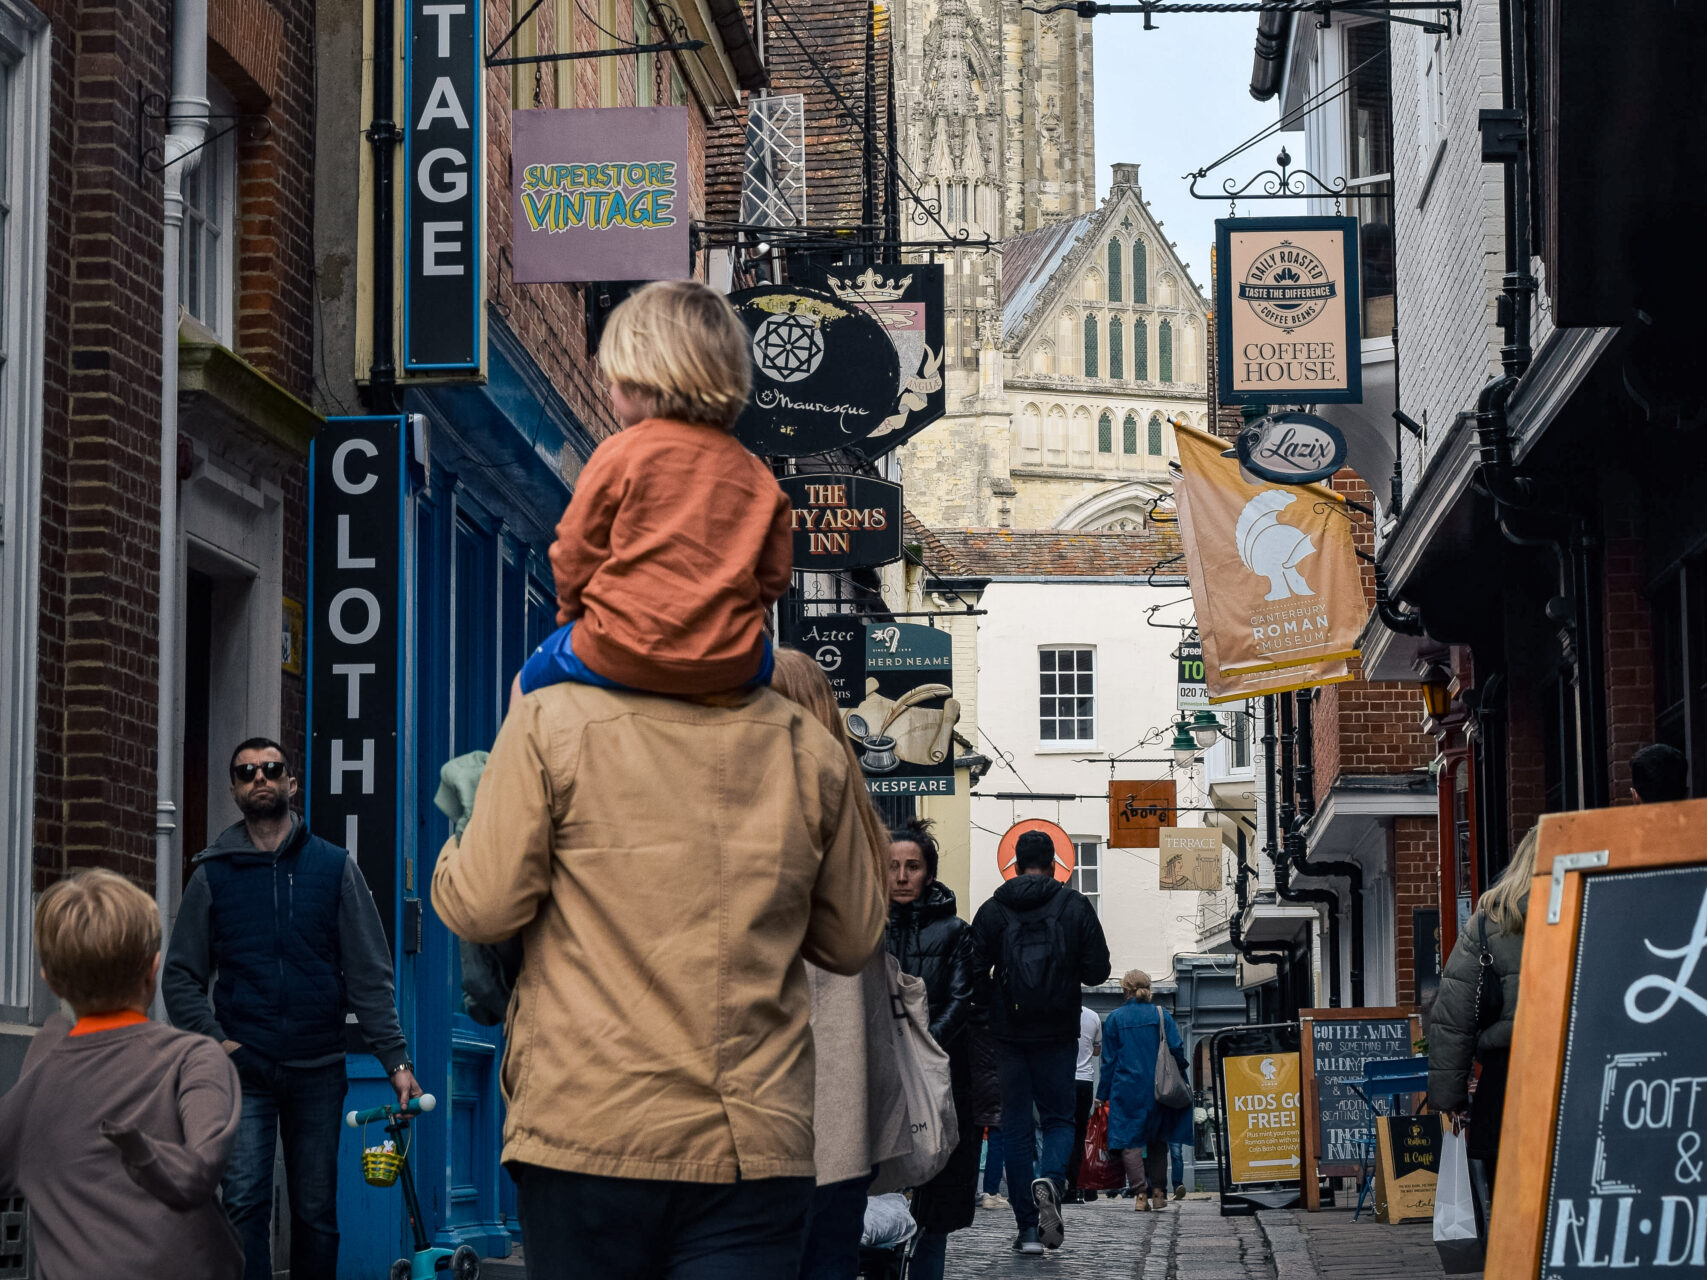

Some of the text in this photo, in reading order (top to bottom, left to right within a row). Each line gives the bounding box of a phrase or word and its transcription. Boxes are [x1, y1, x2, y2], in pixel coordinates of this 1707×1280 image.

[522, 161, 677, 190] SUPERSTORE
[521, 189, 677, 233] VINTAGE
[1251, 251, 1323, 281] DAILY ROASTED
[1245, 286, 1331, 298] TASTE THE DIFFERENCE
[1260, 306, 1316, 325] COFFEE BEANS
[1244, 342, 1336, 361] COFFEE
[1244, 362, 1336, 382] HOUSE
[804, 484, 846, 506] THE
[790, 508, 887, 530] TY ARMS
[808, 533, 849, 554] INN
[1250, 604, 1327, 625] CANTERBURY
[802, 626, 855, 641] Aztec
[1253, 614, 1330, 640] ROMAN
[1261, 631, 1325, 651] MUSEUM
[868, 657, 950, 667] HERD NEAME
[1181, 661, 1205, 680] TO
[828, 678, 846, 687] ver
[1180, 687, 1197, 698] 020
[1166, 838, 1216, 851] TERRACE
[1366, 1024, 1407, 1039] WINE
[1317, 1041, 1333, 1051] AND
[1339, 1041, 1382, 1051] SOMETHING
[1234, 1093, 1277, 1111] KIDS
[1338, 1099, 1389, 1111] ADDITINAL
[1623, 1077, 1707, 1130] COFF
[1247, 1111, 1297, 1129] FREE!
[1322, 1110, 1360, 1121] SEATING
[1273, 1130, 1286, 1138] your
[1676, 1131, 1703, 1184] &
